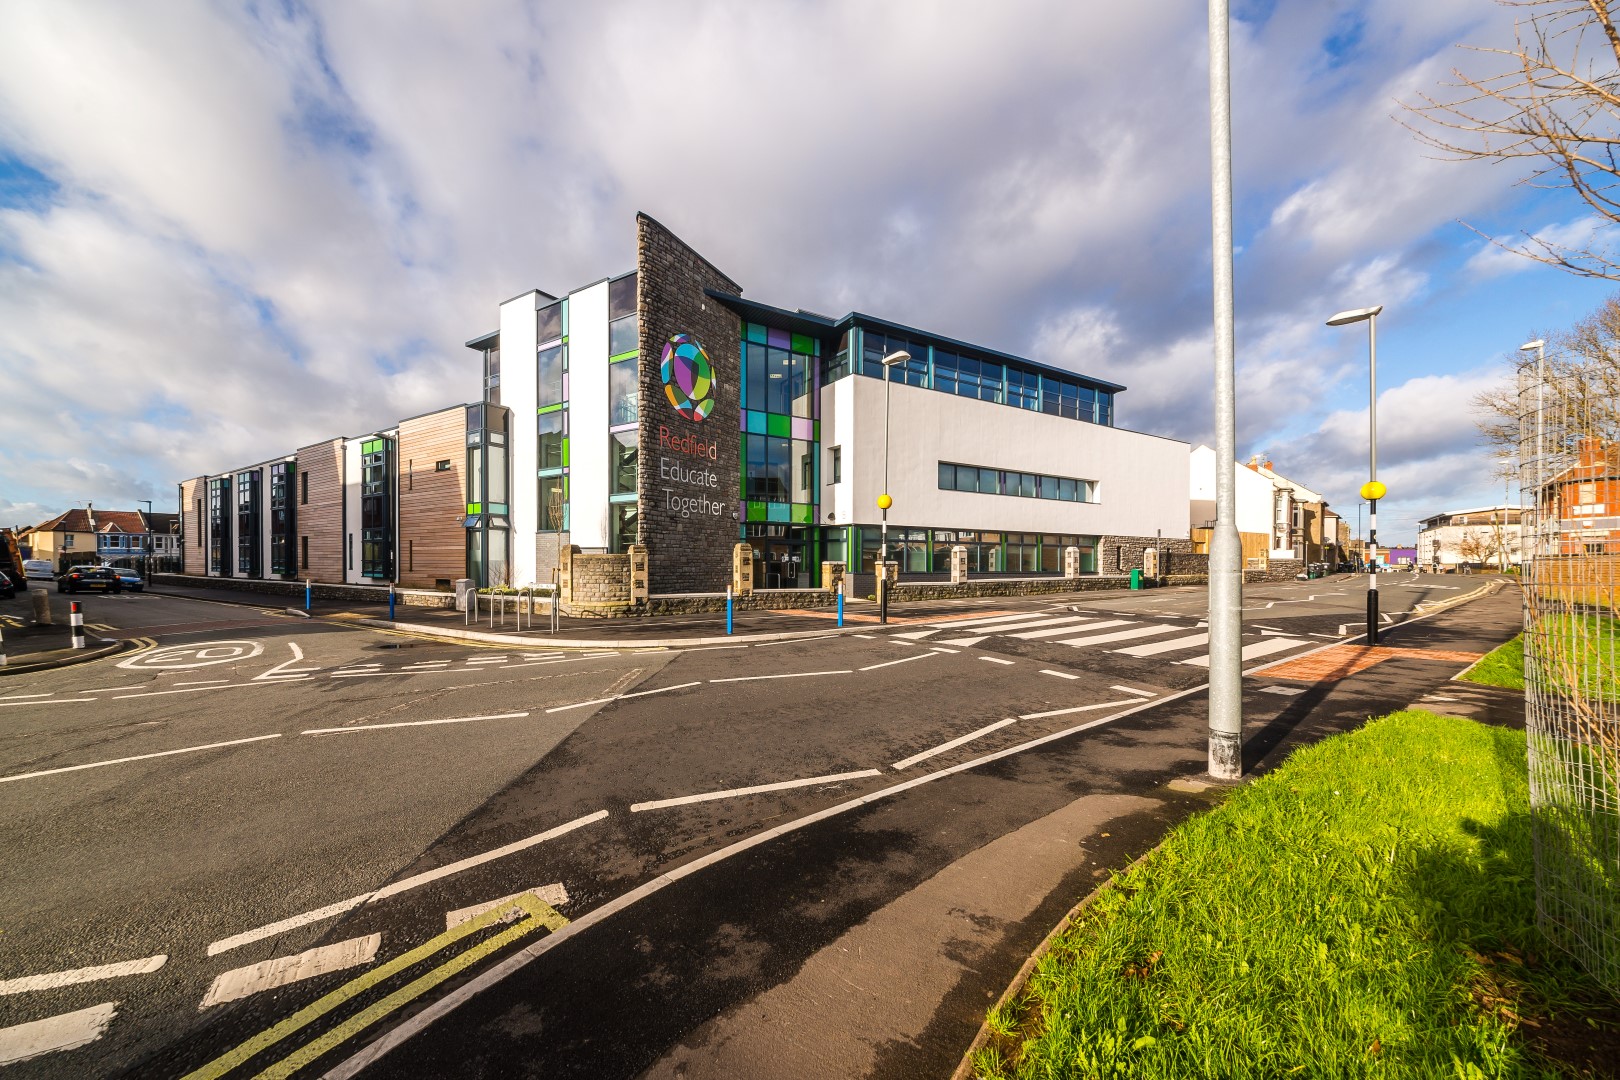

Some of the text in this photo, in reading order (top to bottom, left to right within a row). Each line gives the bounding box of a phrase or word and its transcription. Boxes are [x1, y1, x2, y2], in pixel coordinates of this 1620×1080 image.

[660, 425, 717, 460] Redfield
[660, 457, 718, 488] Educate
[661, 487, 726, 518] Together
